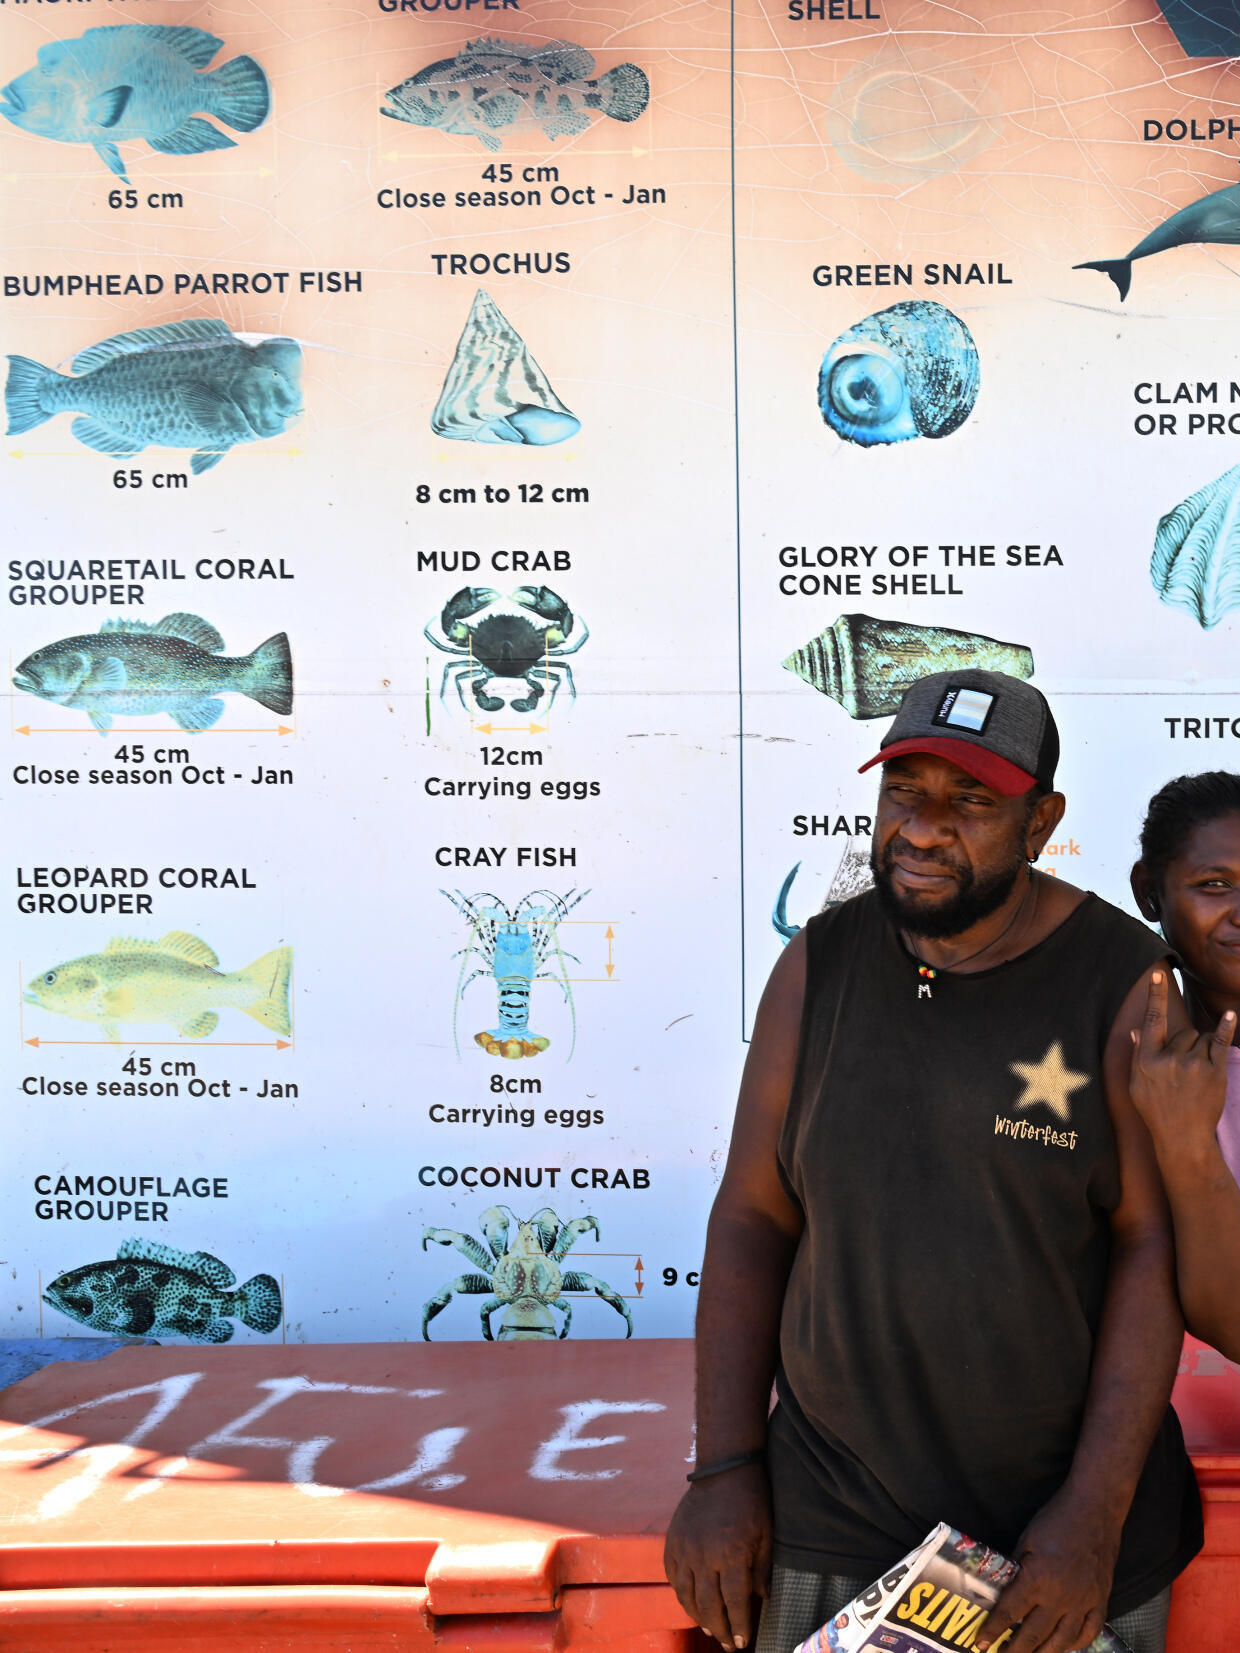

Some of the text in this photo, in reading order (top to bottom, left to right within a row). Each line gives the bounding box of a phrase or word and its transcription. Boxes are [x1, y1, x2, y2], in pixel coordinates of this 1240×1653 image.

[787, 0, 881, 21] SHELL
[482, 164, 558, 183] 45 cm
[109, 190, 182, 209] 65 cm
[378, 189, 445, 208] Close
[456, 191, 540, 207] season
[551, 186, 595, 205] Oct
[622, 185, 665, 204] Jan
[431, 252, 570, 275] TROCHUS
[4, 272, 361, 296] BUMPHEAD PARROT FISH
[813, 263, 1012, 286] GREEN SNAIL
[1134, 382, 1217, 404] CLAM
[1135, 414, 1176, 435] OR
[113, 470, 187, 488] 65 cm
[416, 484, 588, 503] 8 cm to 12 cm
[418, 551, 571, 571] MUD CRAB
[779, 545, 1063, 567] GLORY OF THE SEA
[9, 559, 294, 580] SQUARETAIL CORAL
[9, 585, 144, 605] GROUPER
[780, 574, 963, 595] CONE SHELL
[115, 745, 189, 763] 45 cm
[480, 747, 542, 765] 12cm
[14, 765, 79, 784] Close
[89, 770, 172, 784] season
[182, 766, 224, 784] Oct
[251, 766, 292, 784] Jan
[425, 777, 600, 800] Carrying eggs
[792, 815, 873, 837] SHAR
[436, 847, 576, 866] CRAY FISH
[1040, 838, 1082, 856] ark
[18, 868, 256, 888] LEOPARD CORAL
[18, 894, 152, 914] GROUPER
[122, 1058, 195, 1076] 45 cm
[23, 1077, 87, 1095] Close
[97, 1082, 178, 1096] season
[188, 1079, 230, 1097] Oct
[257, 1080, 298, 1098] Jan
[490, 1075, 541, 1093] 8cm
[429, 1104, 603, 1128] Carrying eggs
[994, 1114, 1079, 1150] Winterfest
[35, 1175, 228, 1198] CAMOUFLAGE
[419, 1166, 650, 1189] COCONUT CRAB
[35, 1200, 168, 1221] GROUPER
[663, 1268, 700, 1287] 9 c
